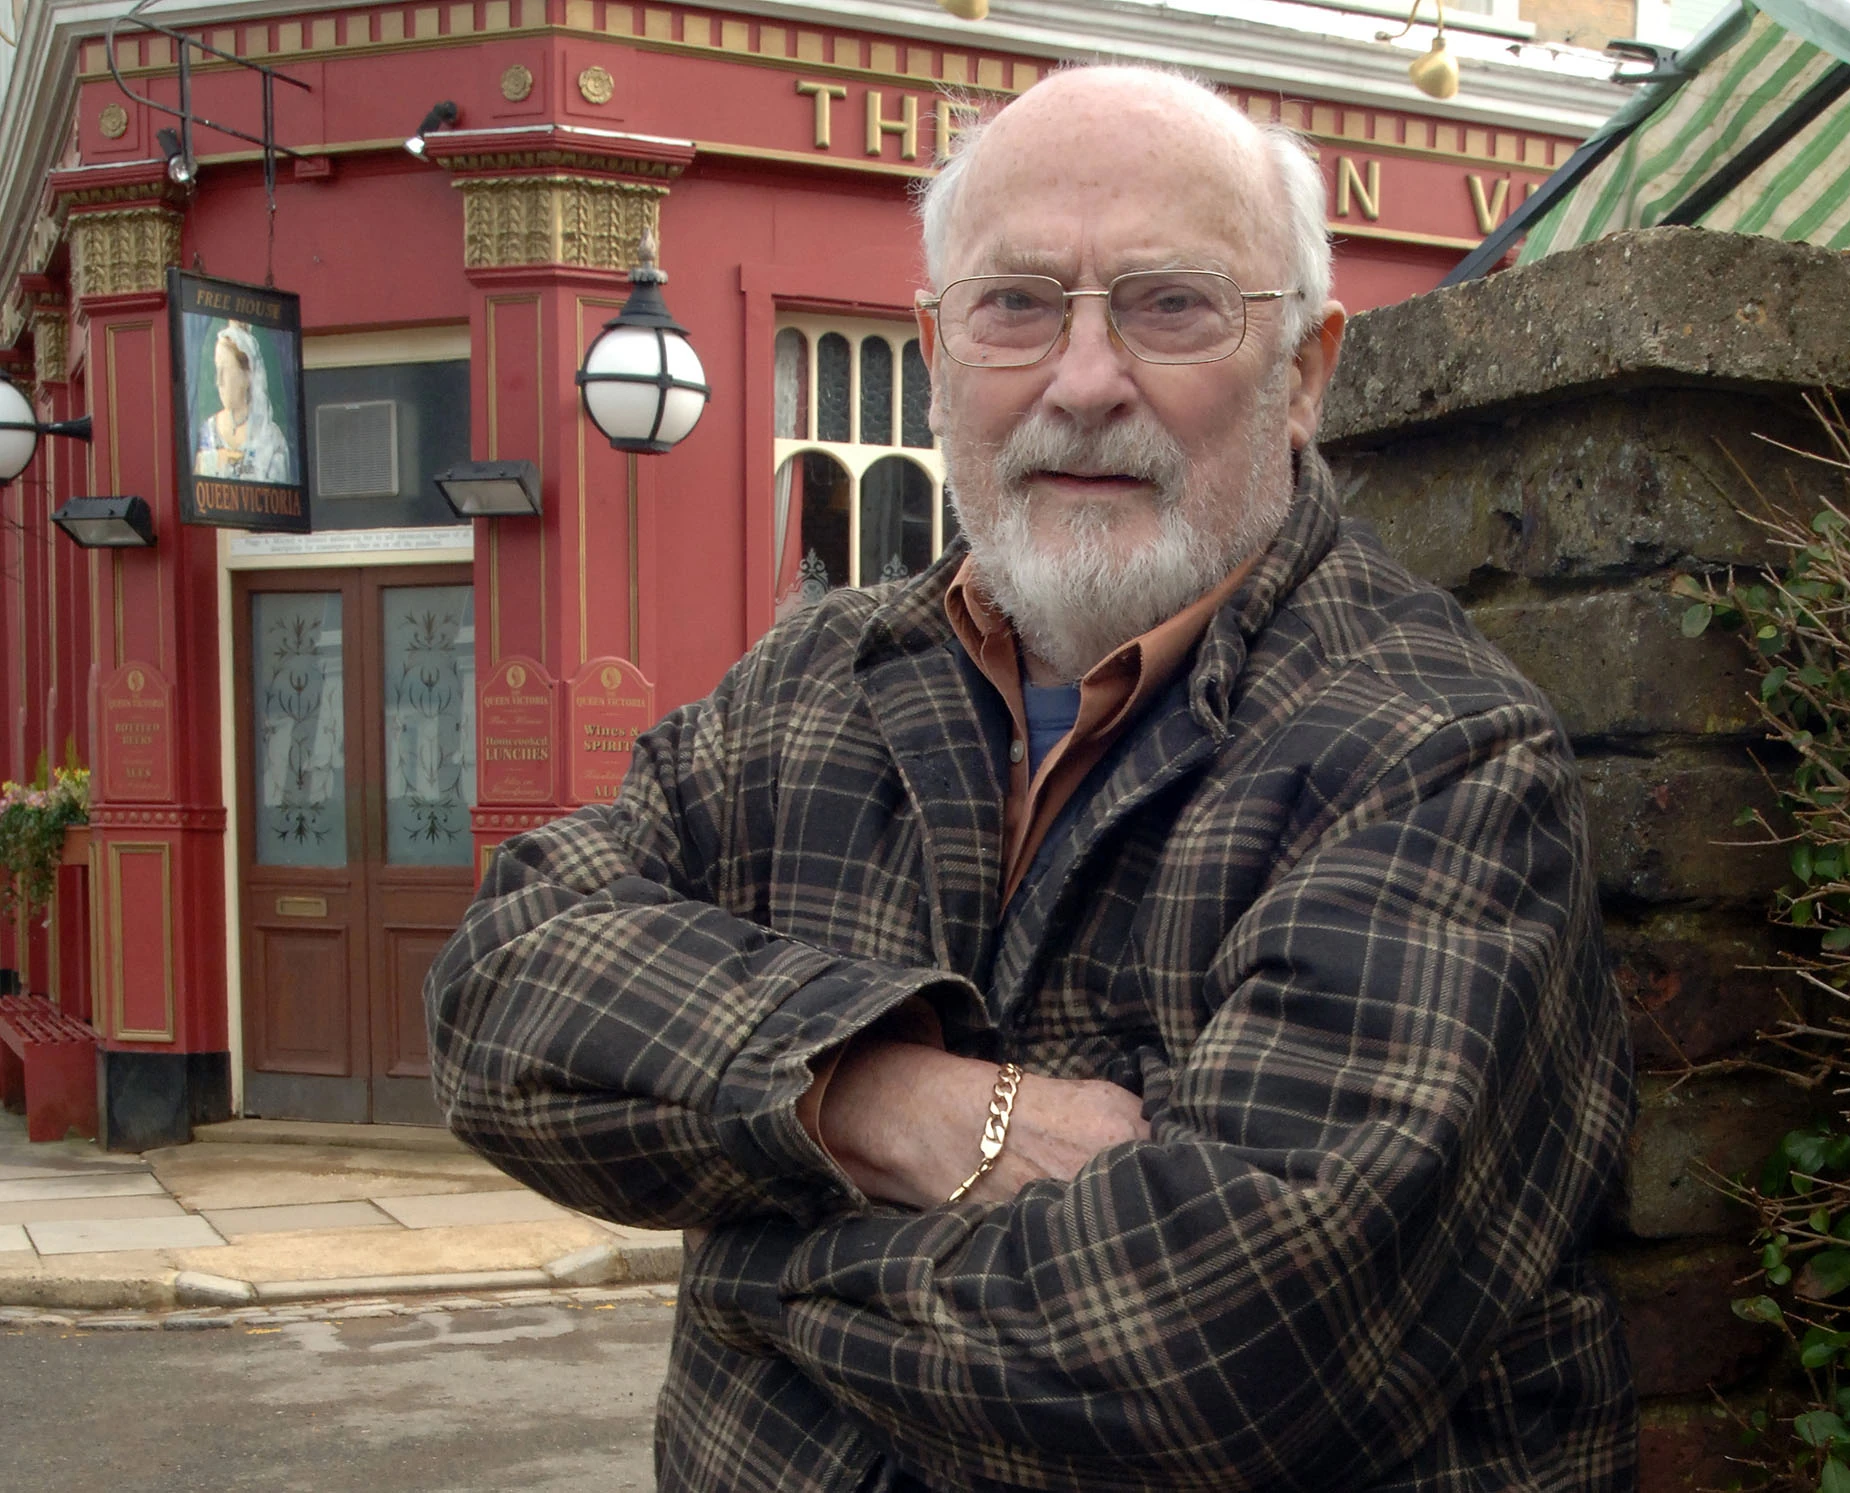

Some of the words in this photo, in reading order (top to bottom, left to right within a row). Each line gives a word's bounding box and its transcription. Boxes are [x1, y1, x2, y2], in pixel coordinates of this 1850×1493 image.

[196, 288, 231, 310] FREE
[235, 297, 280, 320] HOUSE
[195, 481, 239, 514] QUEEN
[241, 486, 302, 516] VICTORIA
[484, 696, 510, 708] QUEEN
[512, 695, 549, 706] VICTORIA
[583, 724, 626, 737] Wines
[630, 726, 640, 737] &
[583, 740, 635, 753] SPIRIT
[485, 748, 549, 761] LUNCHES
[594, 785, 621, 798] ALE
